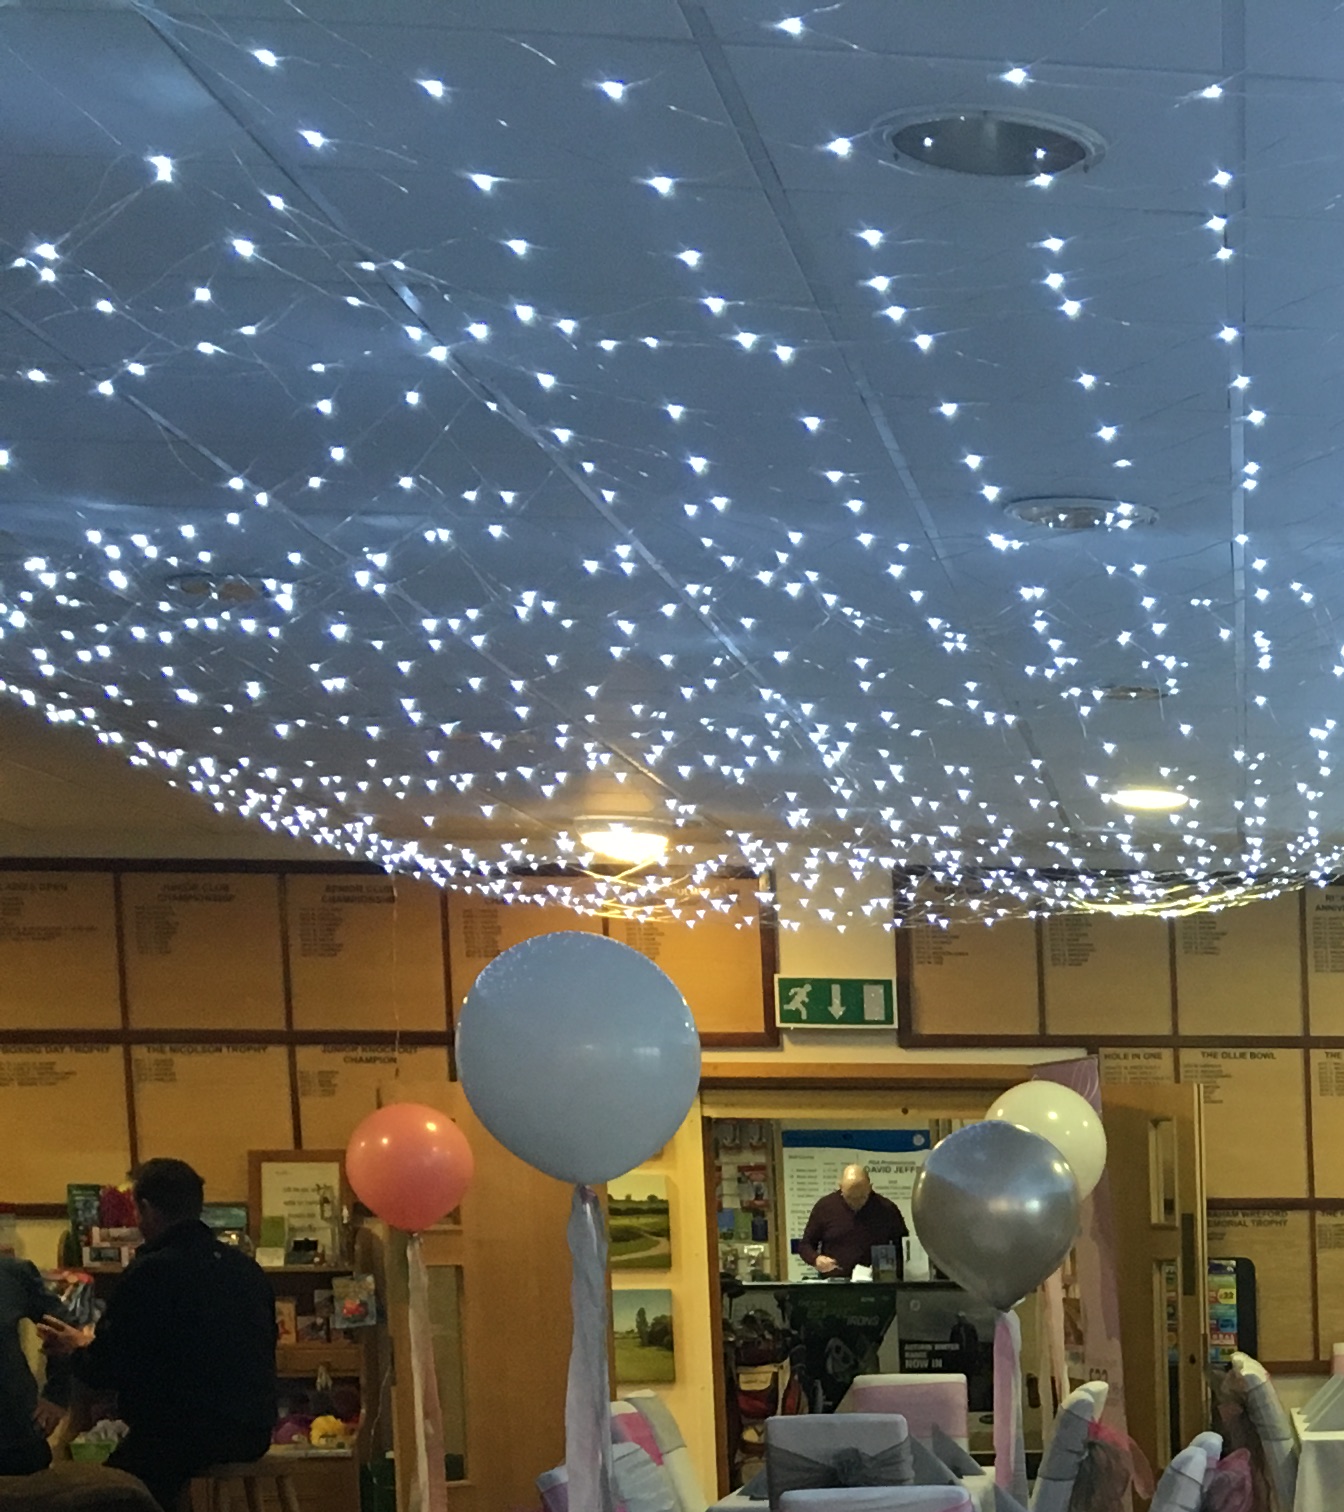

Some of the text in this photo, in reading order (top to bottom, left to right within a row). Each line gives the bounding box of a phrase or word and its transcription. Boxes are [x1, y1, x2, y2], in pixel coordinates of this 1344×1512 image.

[343, 1056, 397, 1064] CHAMPION
[1104, 1053, 1129, 1061] HOLE
[1143, 1052, 1163, 1060] ONE
[1201, 1051, 1219, 1060] THE
[1249, 1051, 1277, 1060] BOWL
[1325, 1051, 1343, 1060] THE
[1207, 1219, 1288, 1228] EMORIAL TROPHY
[905, 1358, 944, 1369] NOW IN
